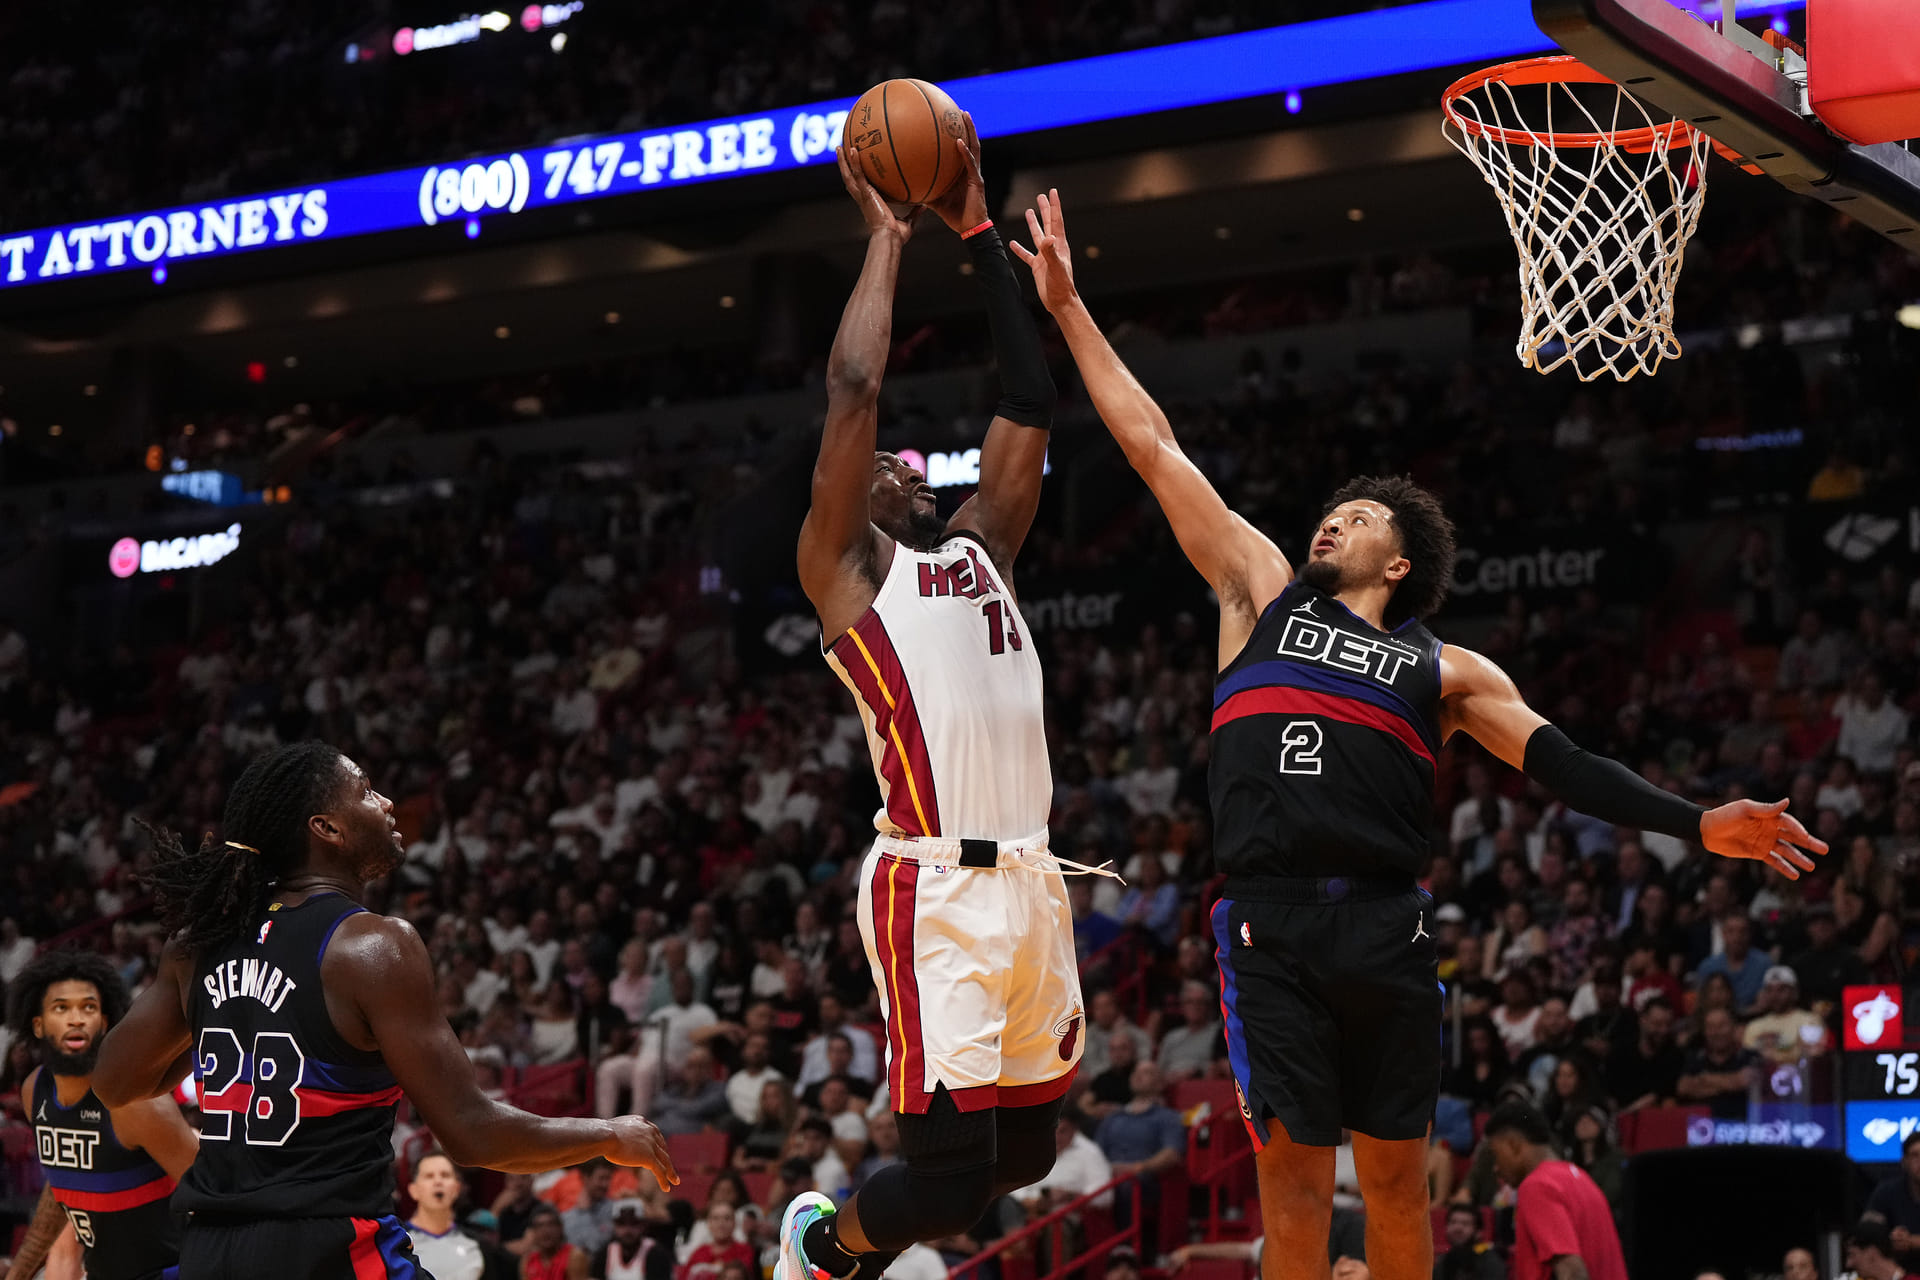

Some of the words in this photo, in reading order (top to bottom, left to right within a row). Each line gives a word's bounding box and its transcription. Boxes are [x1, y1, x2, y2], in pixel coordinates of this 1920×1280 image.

[0, 235, 34, 282] T
[38, 189, 328, 277] ATTORNEYS
[419, 153, 530, 226] (800)
[543, 118, 777, 199] 747-FREE
[789, 111, 850, 164] (37
[917, 546, 1001, 600] HEA
[1448, 546, 1608, 596] Center
[1277, 615, 1419, 686] DET
[1279, 721, 1323, 775] 2
[203, 958, 297, 1013] STEWART
[198, 1027, 305, 1146] 28
[1876, 1052, 1919, 1095] 75
[80, 1109, 101, 1121] UWM
[36, 1125, 100, 1170] DET
